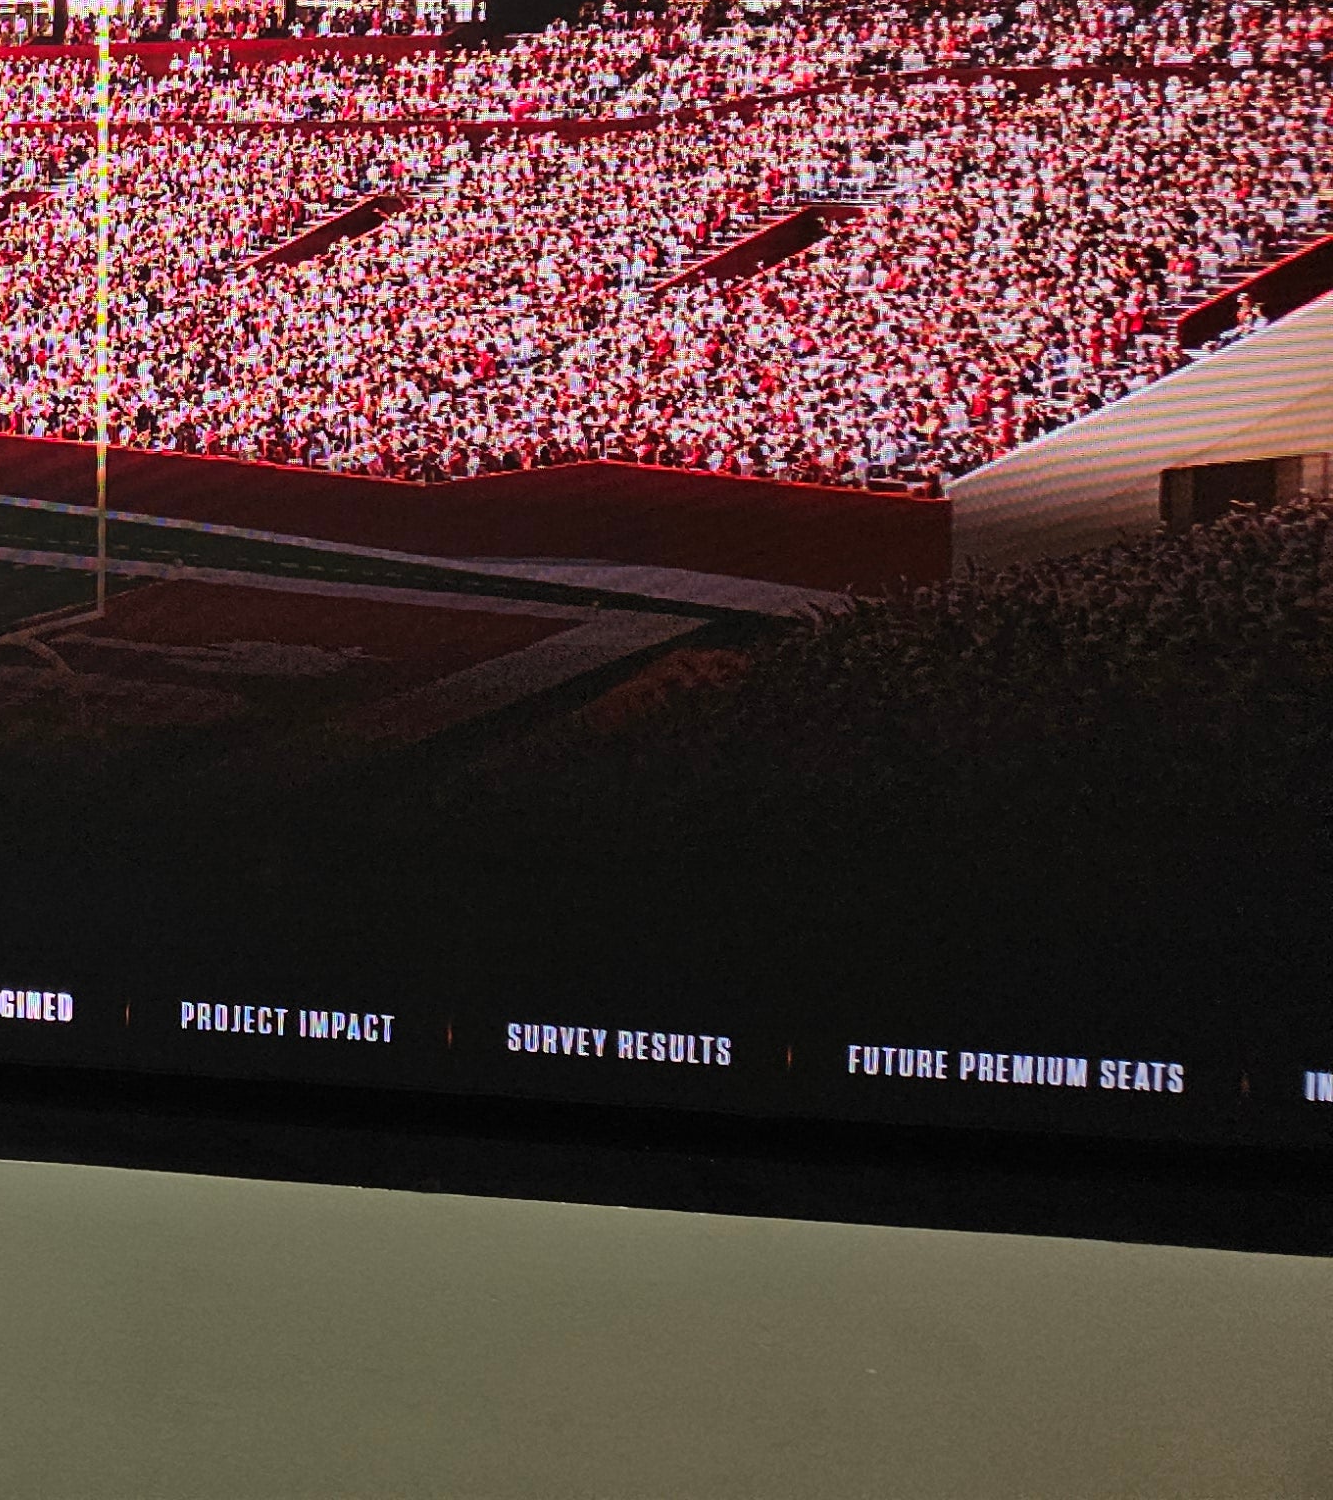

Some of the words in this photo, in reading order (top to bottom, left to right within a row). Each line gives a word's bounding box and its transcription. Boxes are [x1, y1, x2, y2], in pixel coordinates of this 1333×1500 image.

[180, 1001, 289, 1036] PROJECT
[299, 1009, 395, 1043] IMPACT
[507, 1022, 607, 1058] SURVEY
[617, 1029, 732, 1067] RESULTS
[848, 1044, 948, 1080] FUTURE
[959, 1051, 1087, 1089] PREMIUM
[1099, 1059, 1184, 1094] SEATS
